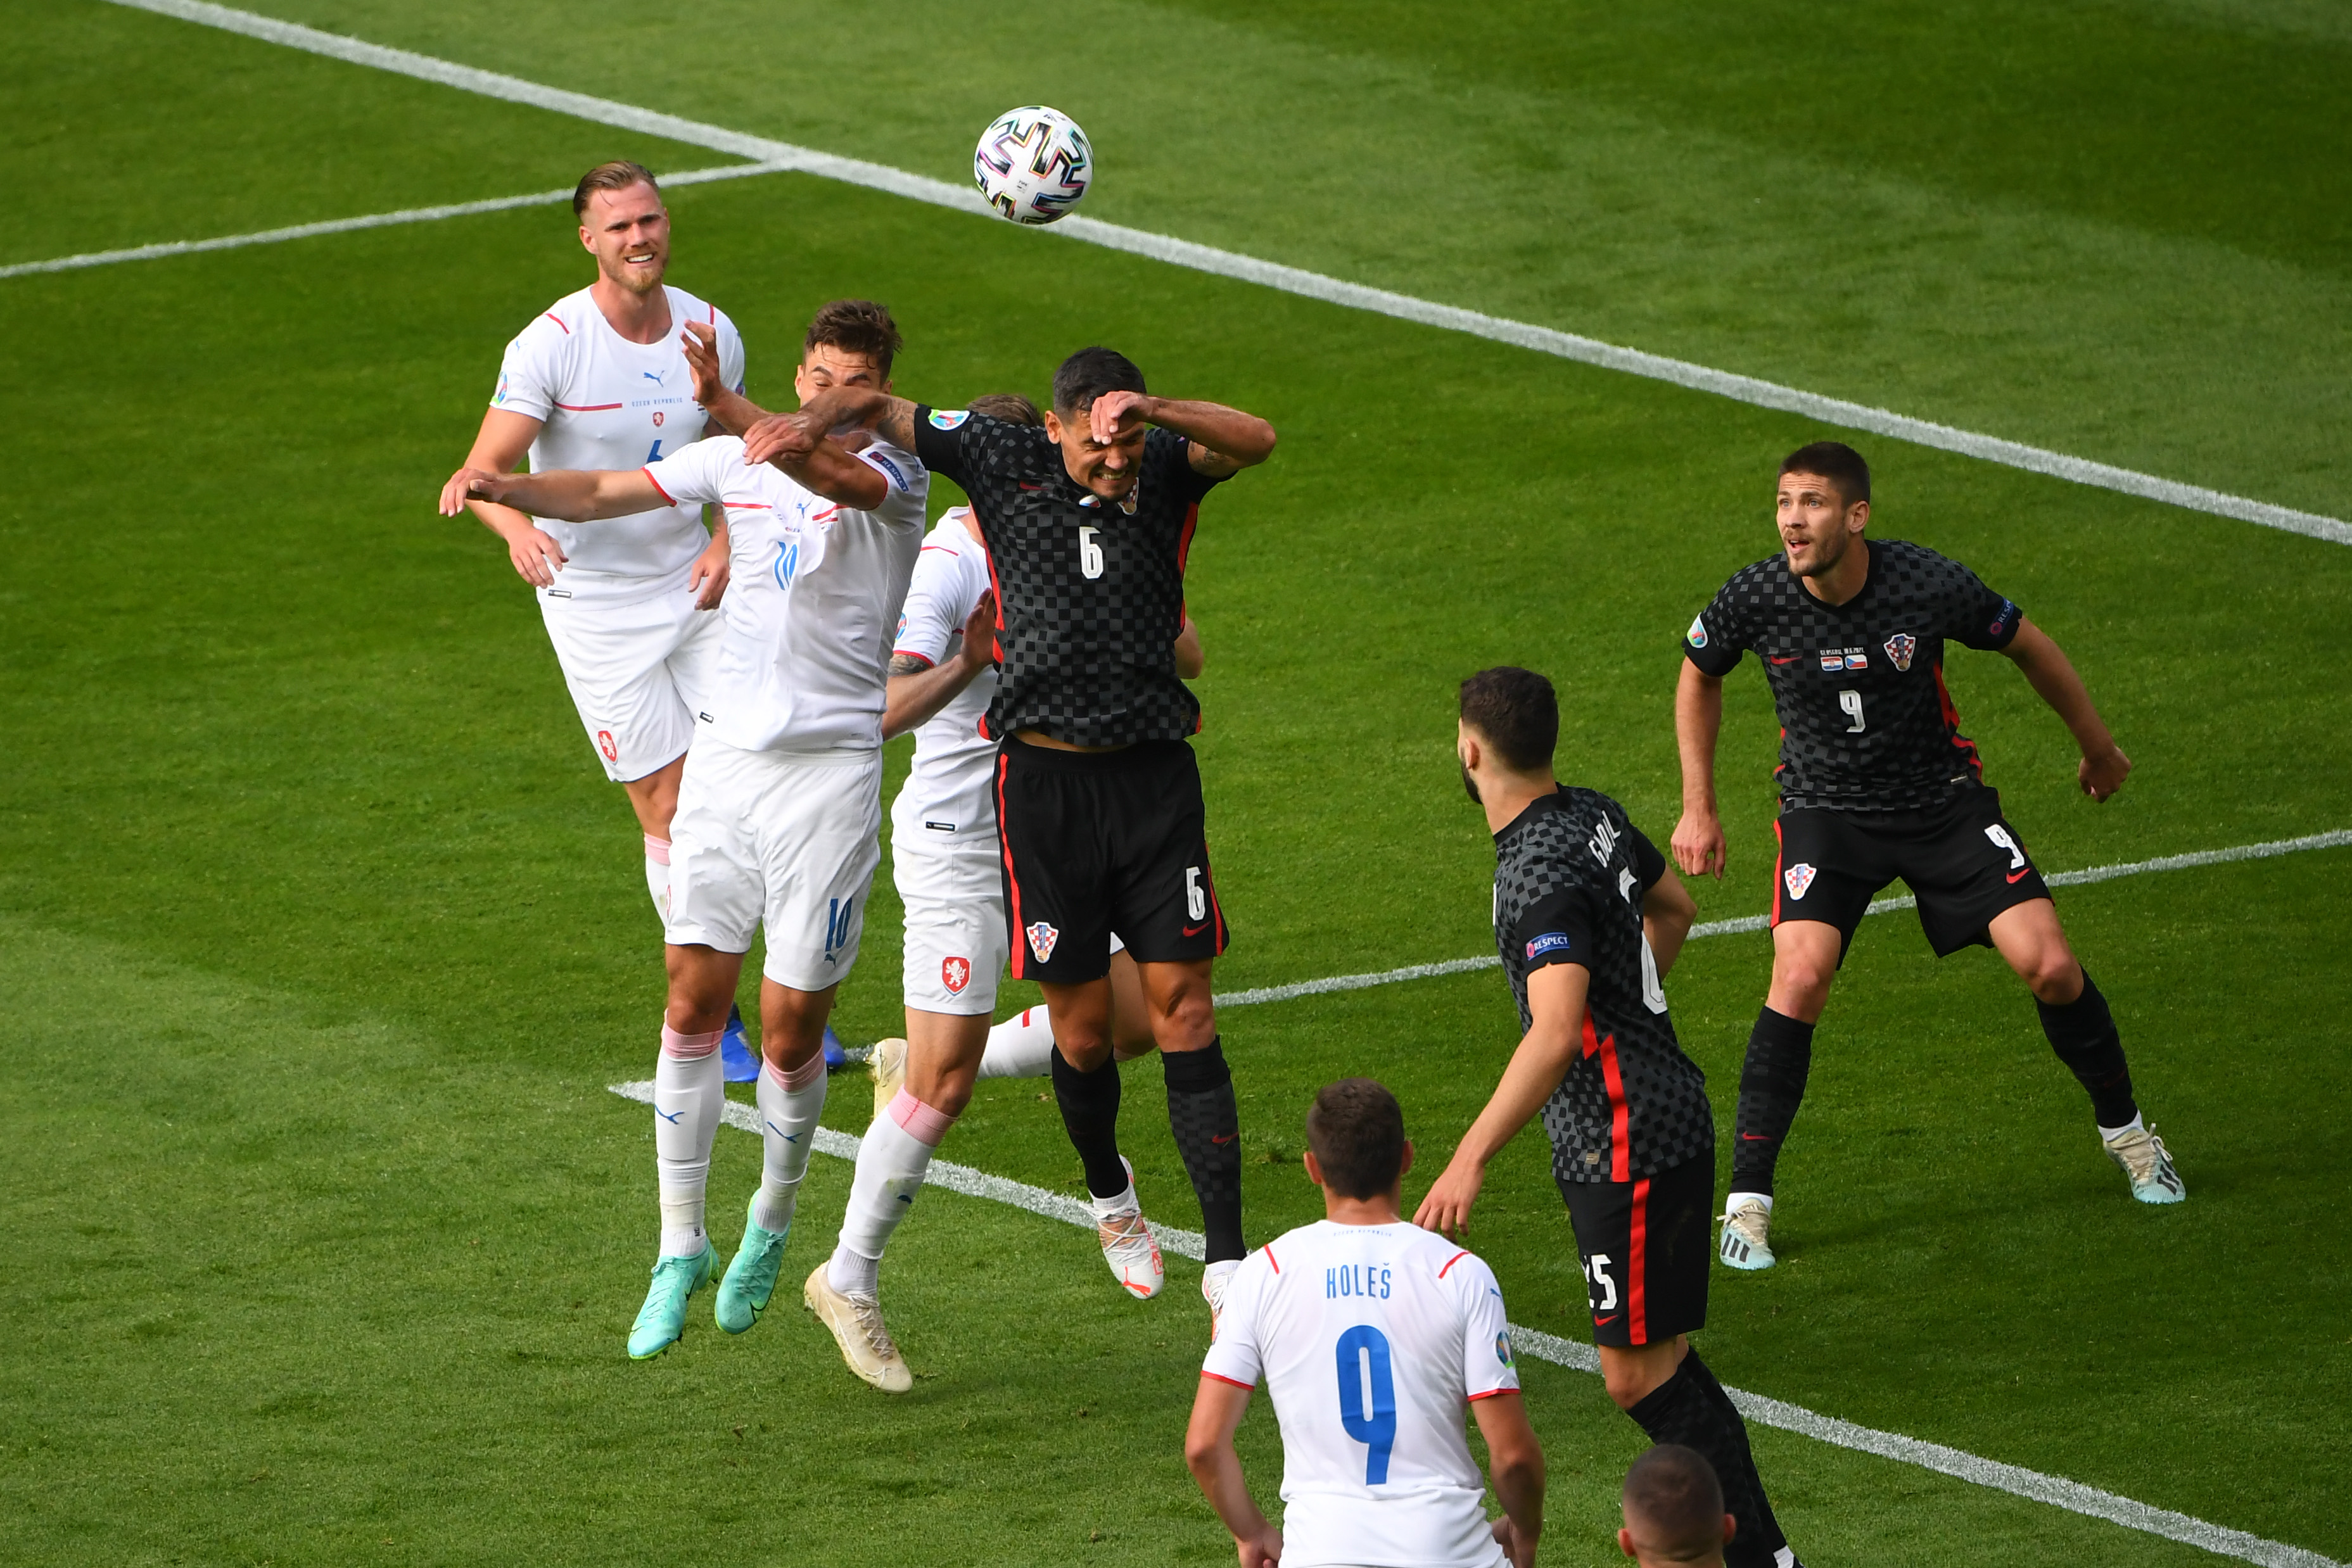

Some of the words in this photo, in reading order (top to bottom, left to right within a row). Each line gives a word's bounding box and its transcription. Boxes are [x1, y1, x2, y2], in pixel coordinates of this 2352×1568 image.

[774, 540, 798, 591] 10
[1079, 526, 1103, 579] 6
[1839, 689, 1866, 733] 9
[1984, 823, 2025, 869] 9
[1186, 866, 1206, 921] 6
[825, 897, 853, 952] 10
[1534, 936, 1568, 951] RESPECT
[1326, 1262, 1392, 1300] HOLEŠ
[1335, 1325, 1397, 1486] 9
